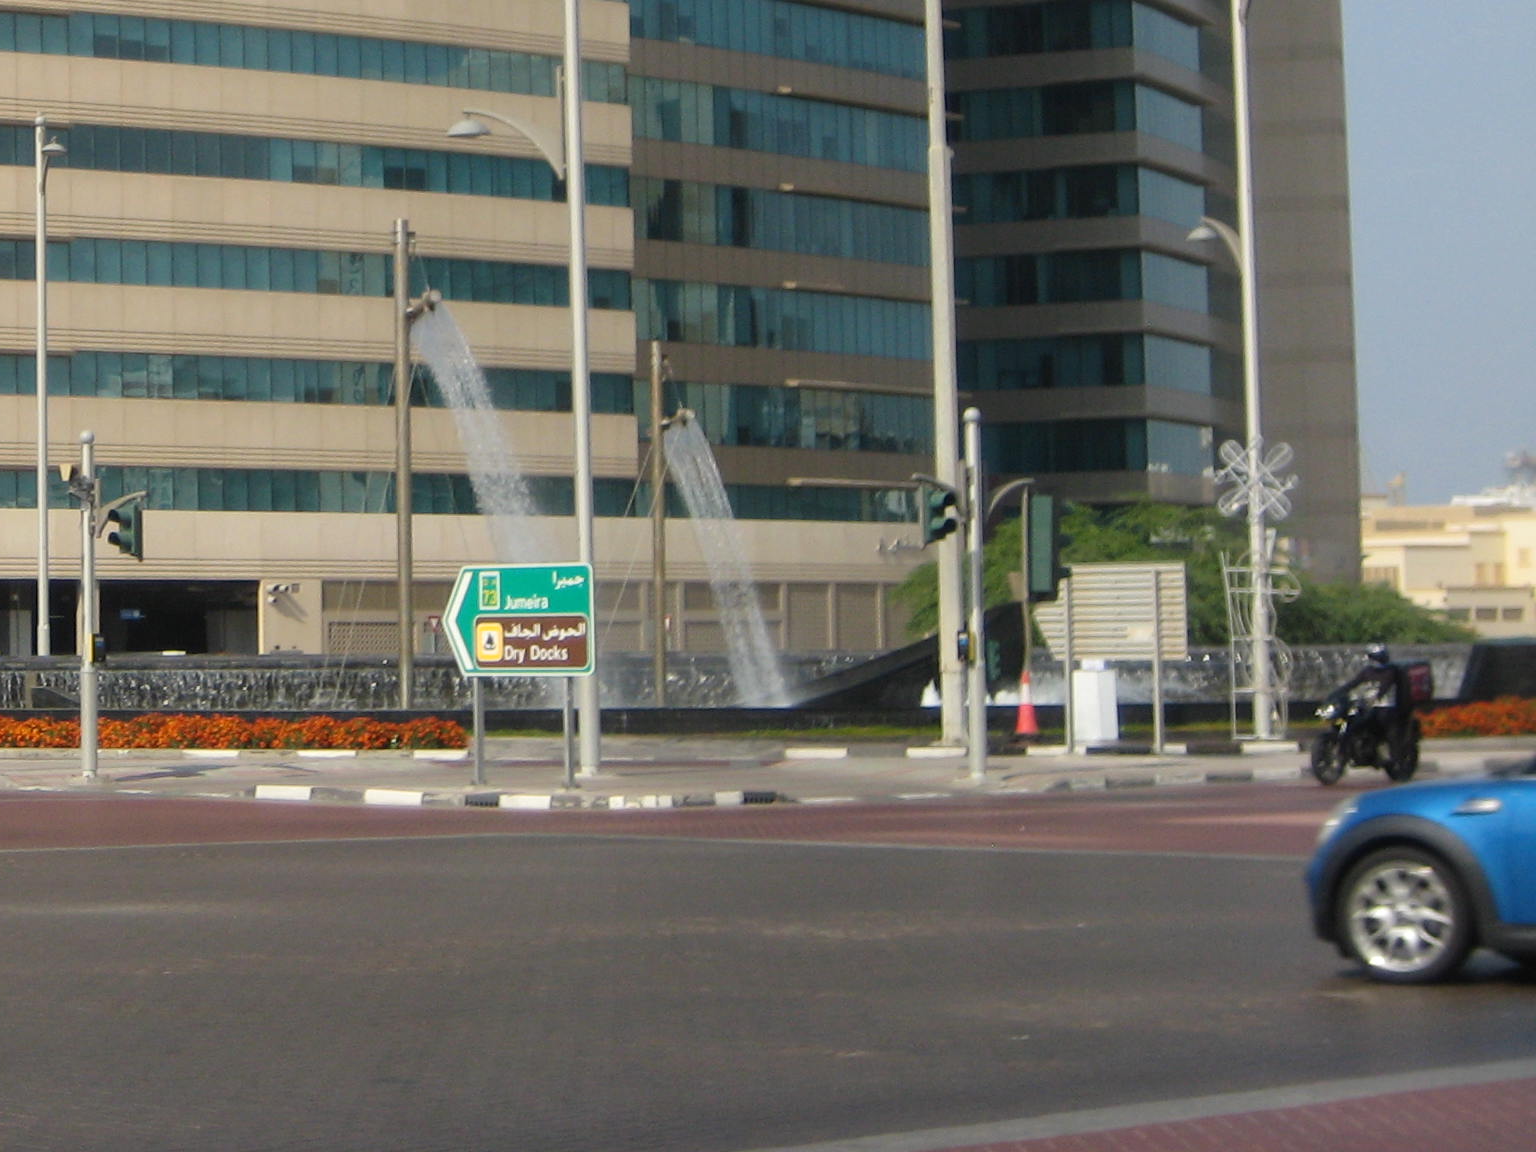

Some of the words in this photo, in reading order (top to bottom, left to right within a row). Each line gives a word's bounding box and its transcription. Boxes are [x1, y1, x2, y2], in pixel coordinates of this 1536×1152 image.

[552, 571, 584, 589] جميرا
[504, 594, 549, 609] Jumeira
[542, 622, 586, 640] الحوض
[504, 646, 525, 663] Dry
[530, 645, 568, 660] Docks
